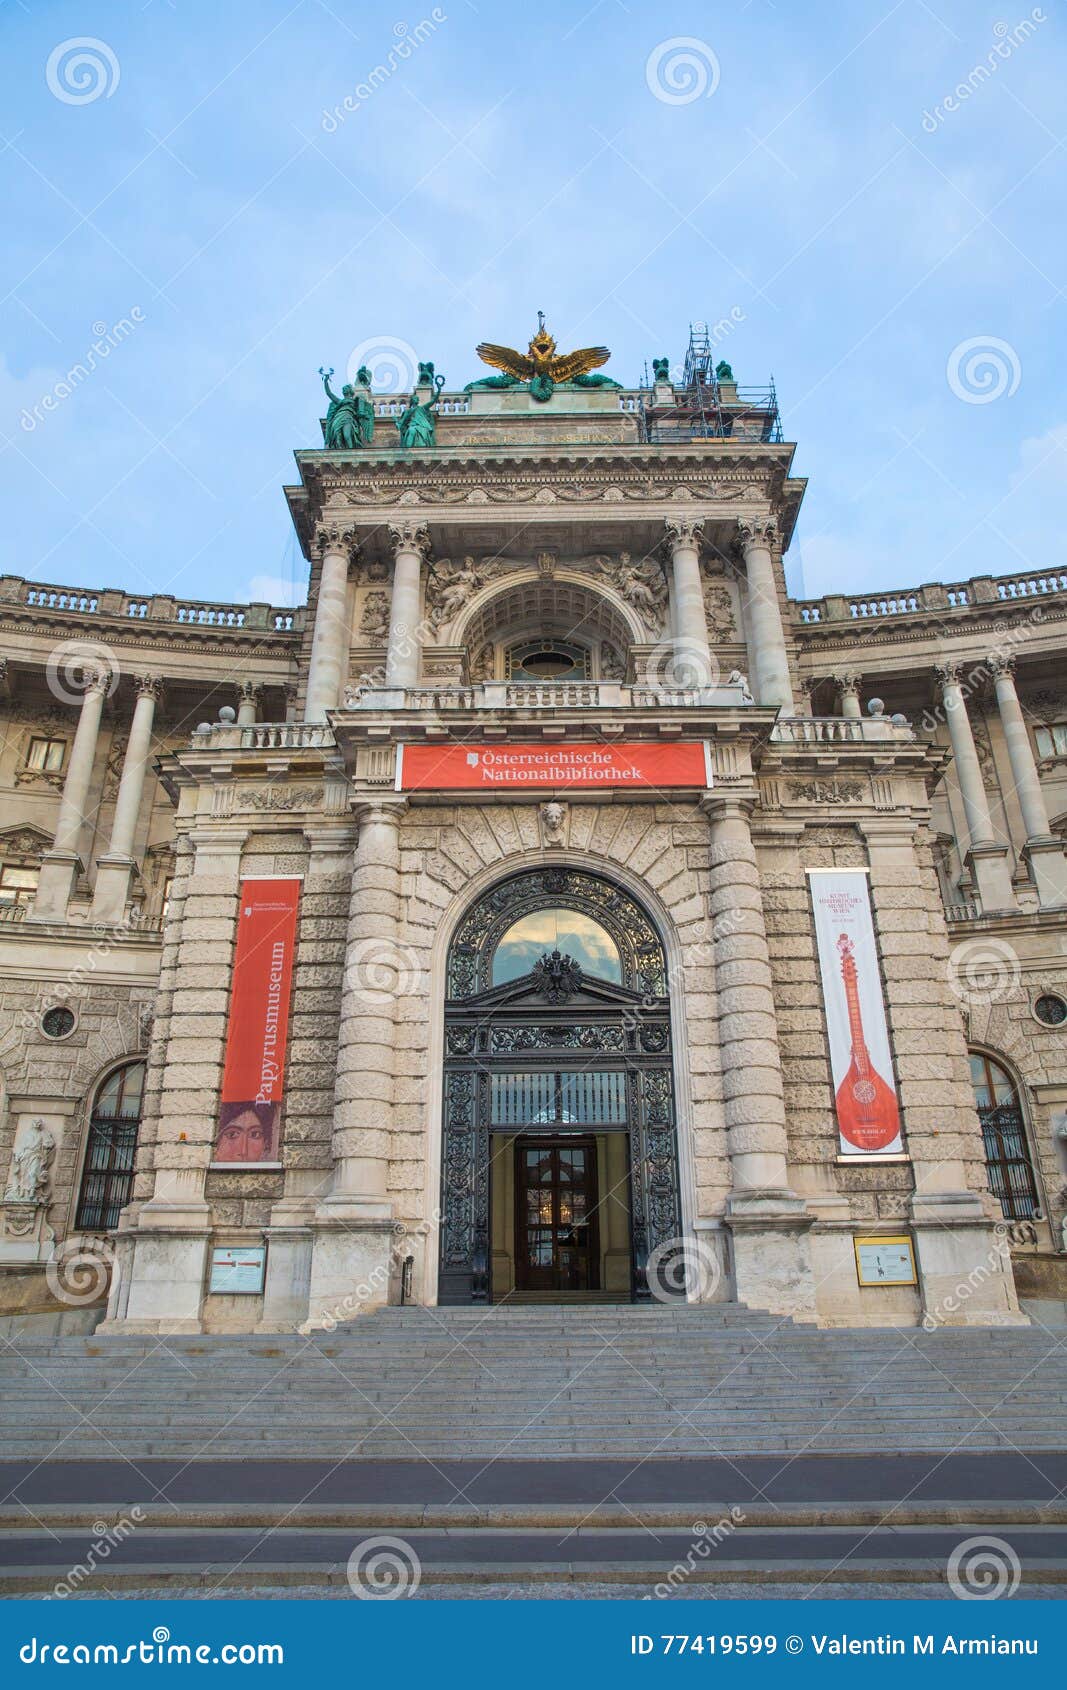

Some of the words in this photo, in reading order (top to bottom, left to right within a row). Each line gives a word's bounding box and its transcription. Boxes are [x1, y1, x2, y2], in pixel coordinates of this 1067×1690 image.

[482, 750, 612, 765] Österreichische
[482, 767, 642, 781] Nationalbibliothek
[255, 941, 285, 1107] Papyrusmuseum
